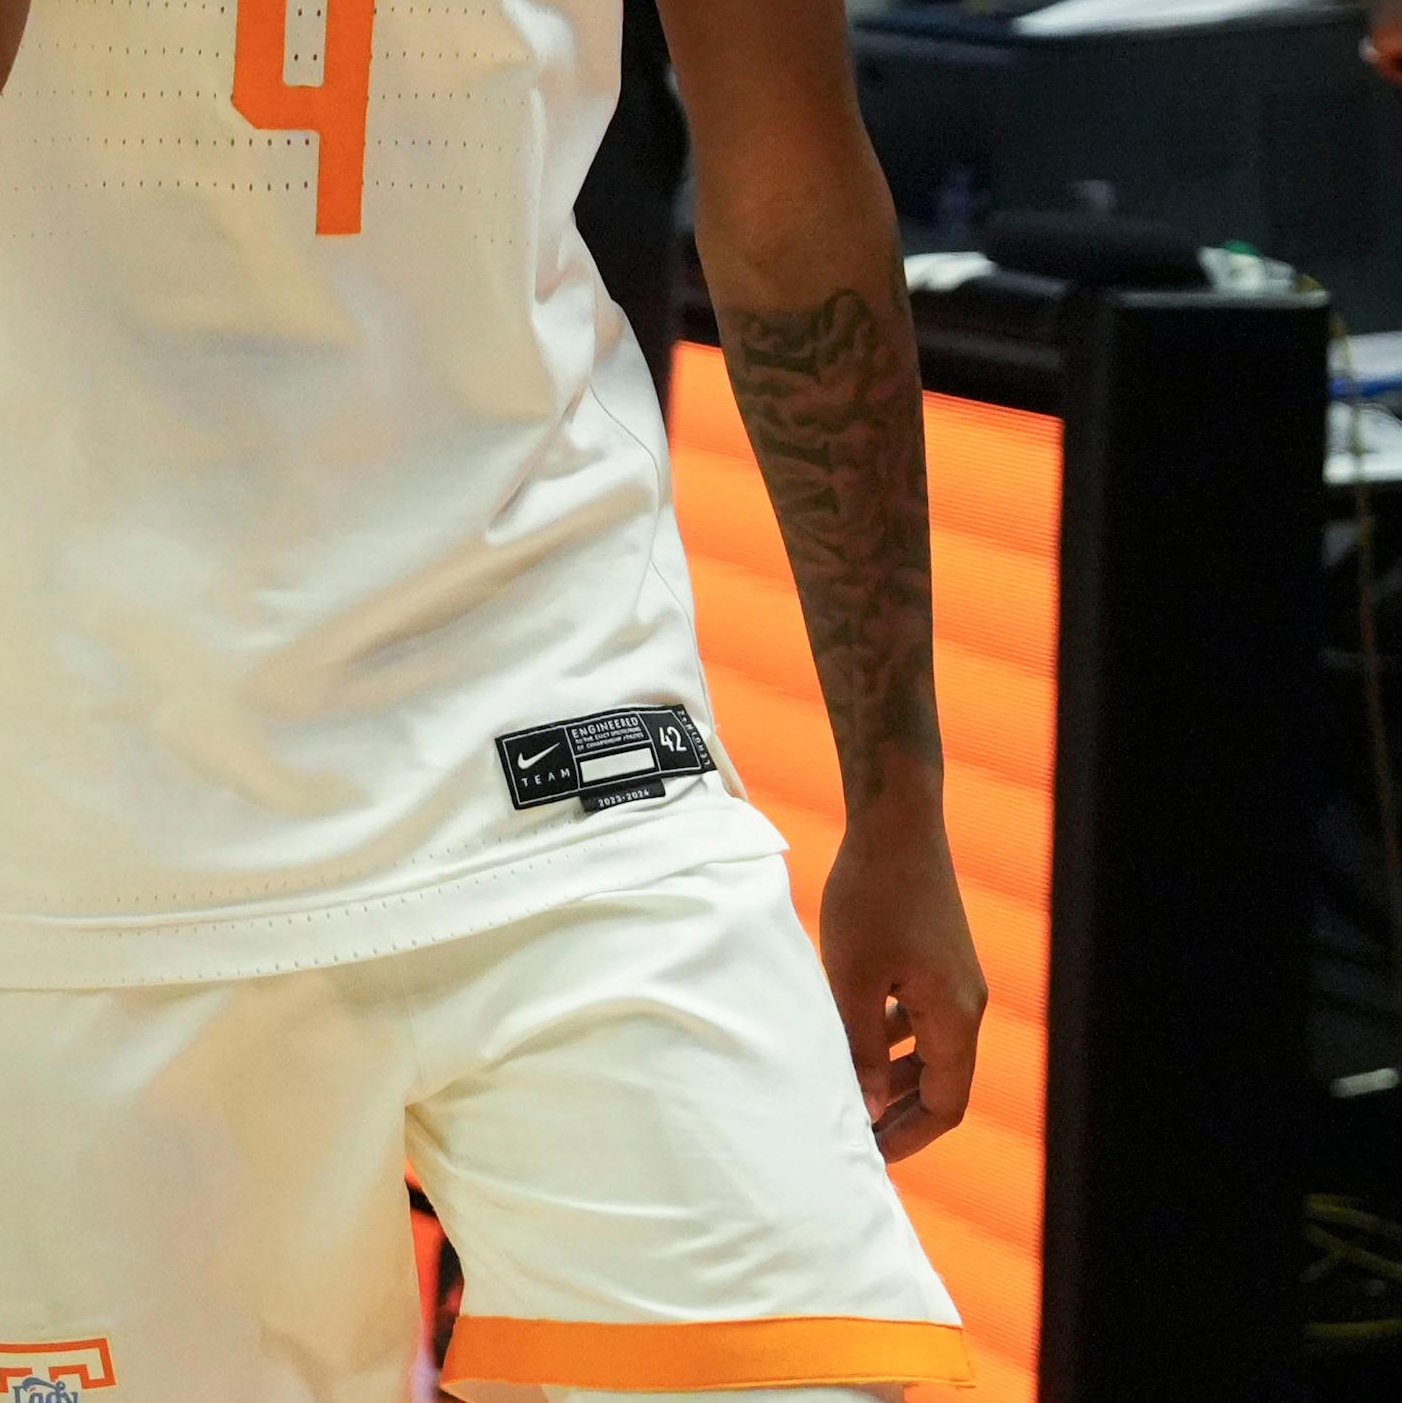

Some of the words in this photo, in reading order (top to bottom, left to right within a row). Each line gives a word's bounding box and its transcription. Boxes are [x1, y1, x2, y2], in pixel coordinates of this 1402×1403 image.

[571, 716, 639, 738] ENGINEERED
[658, 726, 687, 753] 42
[521, 767, 571, 788] TEAM
